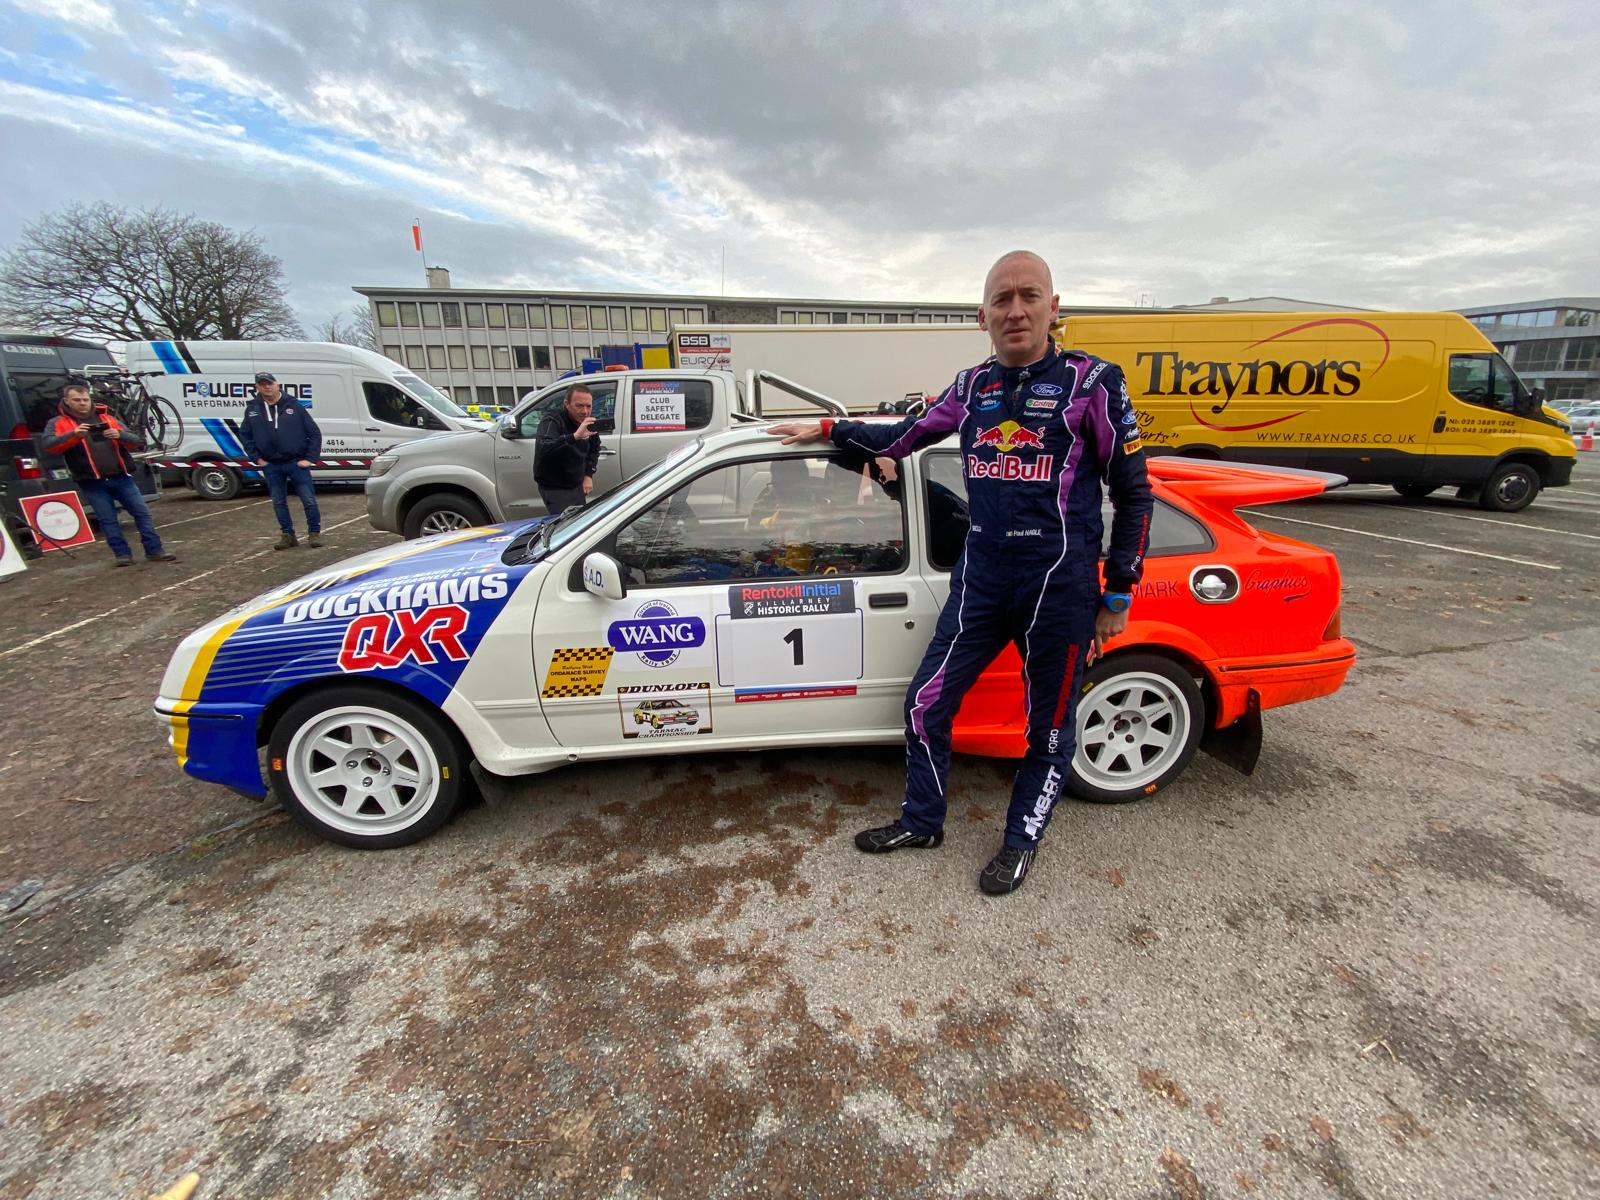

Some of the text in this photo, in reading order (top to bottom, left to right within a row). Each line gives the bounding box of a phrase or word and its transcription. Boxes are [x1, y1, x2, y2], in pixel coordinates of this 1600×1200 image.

[680, 336, 708, 345] BSB
[1082, 363, 1108, 389] sparco
[1136, 351, 1361, 414] Traynors
[183, 382, 312, 398] POWERNE
[1257, 432, 1416, 443] WWW.TRAYNORS.CO.UK
[968, 454, 1053, 481] Red Bull
[283, 572, 508, 624] DUCKHAMS
[757, 603, 830, 615] HISTORIC RALLY
[337, 604, 471, 673] QXR
[619, 623, 695, 646] WANG
[783, 628, 804, 666] 1
[629, 683, 698, 693] DUNLOP
